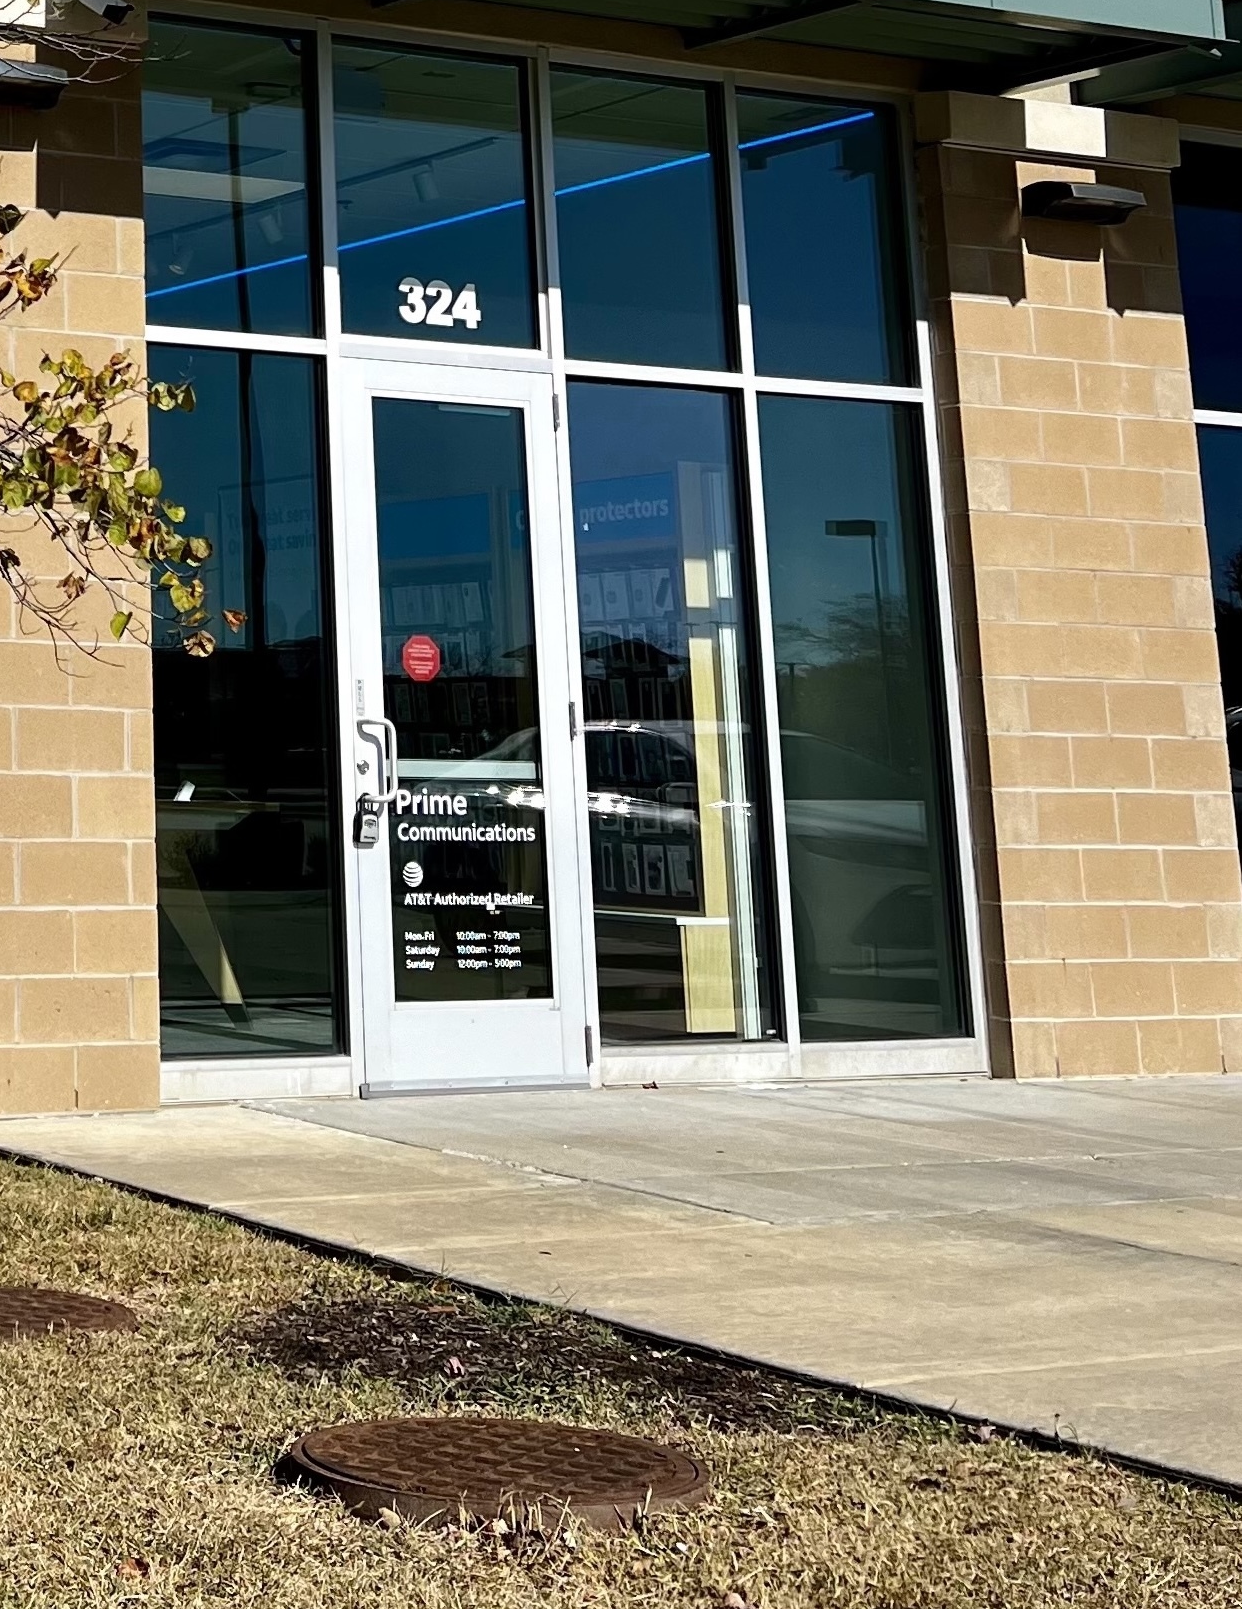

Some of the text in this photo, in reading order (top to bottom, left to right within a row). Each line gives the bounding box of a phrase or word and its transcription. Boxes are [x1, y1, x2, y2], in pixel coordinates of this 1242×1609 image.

[398, 277, 482, 329] 324
[579, 498, 669, 525] protectors
[396, 788, 468, 815] Prime
[397, 822, 536, 842] Communications
[404, 892, 535, 906] AT&T Authorized Retailer
[405, 945, 440, 957] Saturday
[405, 959, 435, 971] Sunday
